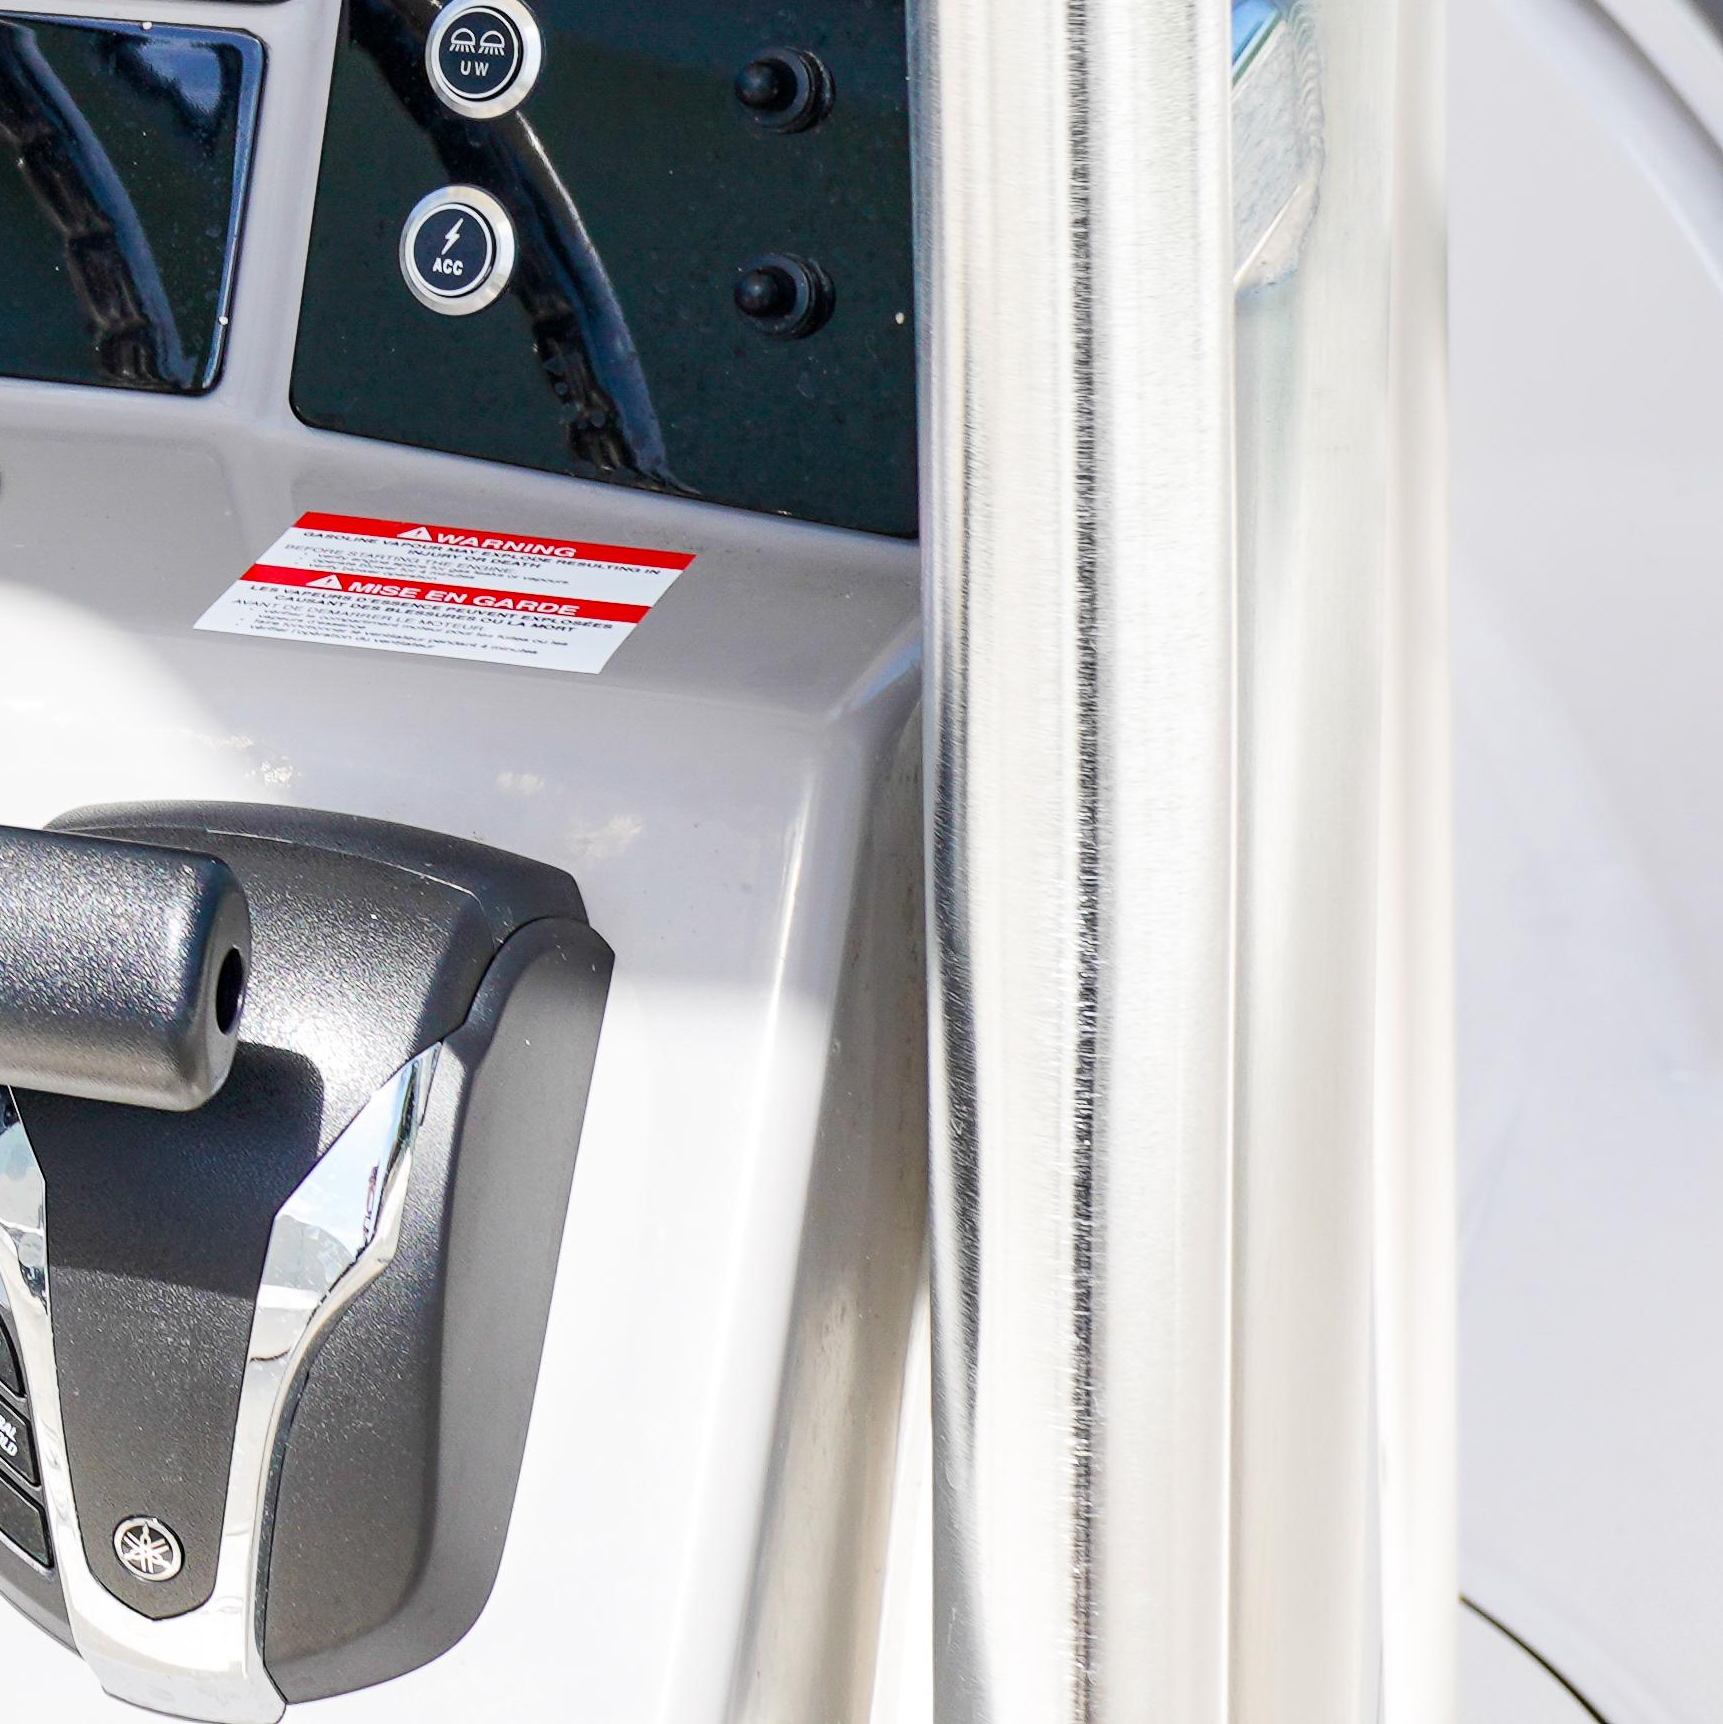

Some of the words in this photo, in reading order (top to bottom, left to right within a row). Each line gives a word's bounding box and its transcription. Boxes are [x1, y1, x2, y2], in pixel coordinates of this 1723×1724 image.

[432, 256, 464, 277] ACC
[436, 533, 577, 558] WARNING
[348, 581, 421, 599] MISE
[424, 590, 467, 605] EN
[473, 595, 581, 616] GARDE
